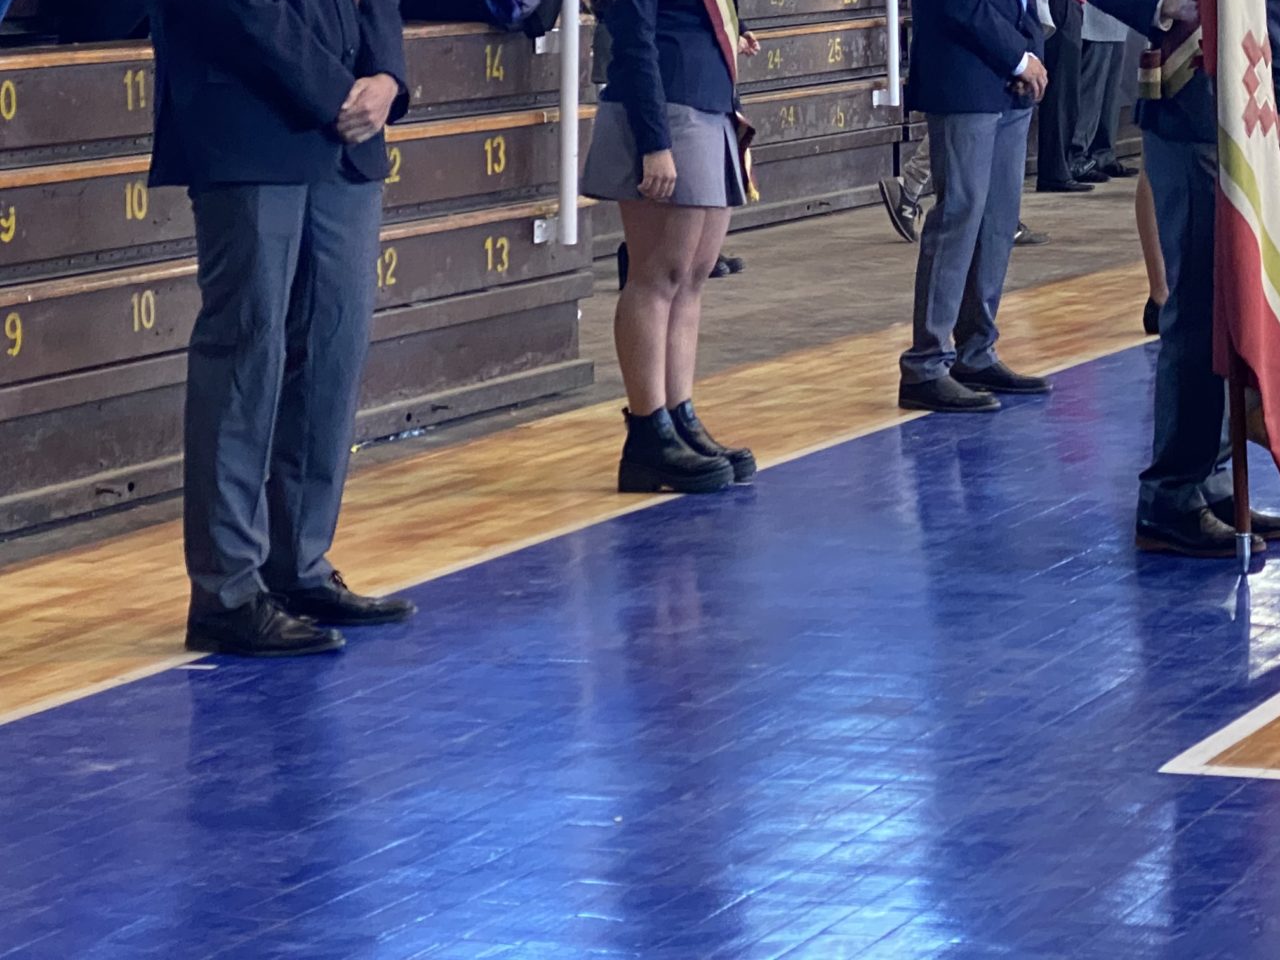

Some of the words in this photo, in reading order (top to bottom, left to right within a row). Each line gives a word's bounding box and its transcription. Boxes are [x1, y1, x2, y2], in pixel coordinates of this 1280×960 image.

[484, 44, 504, 81] 14
[768, 48, 782, 70] 24
[828, 37, 843, 64] 25
[123, 69, 146, 111] 11
[484, 135, 507, 176] 13
[125, 181, 147, 220] 10
[376, 246, 398, 288] 12
[484, 236, 510, 273] 13
[131, 290, 156, 332] 10
[5, 312, 22, 357] 9
